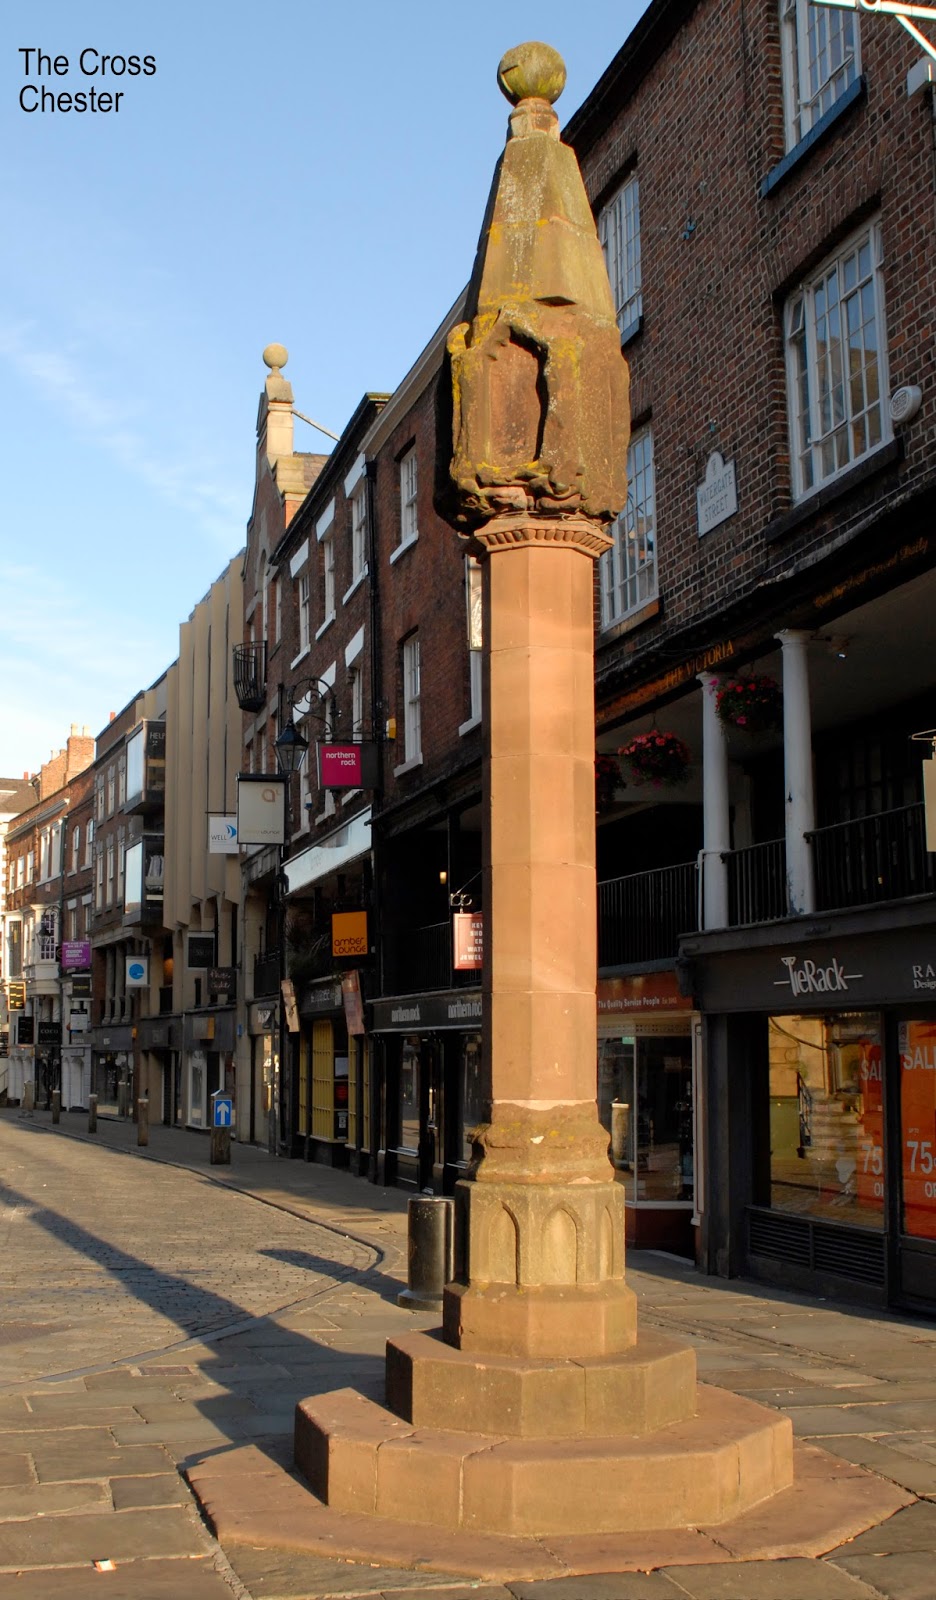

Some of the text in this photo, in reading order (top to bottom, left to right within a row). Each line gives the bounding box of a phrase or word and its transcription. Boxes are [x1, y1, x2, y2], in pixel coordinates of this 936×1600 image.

[699, 470, 733, 507] WATERGATE
[704, 493, 729, 523] STREET
[685, 639, 735, 678] VICTORIA
[149, 731, 166, 739] HELP
[325, 751, 356, 759] northern
[333, 945, 367, 954] LOUNGE
[334, 937, 365, 947] amber
[447, 999, 471, 1018] northern
[598, 1000, 607, 1009] The
[607, 999, 623, 1010] Quality
[623, 997, 642, 1007] Service
[642, 995, 661, 1007] People
[903, 1045, 936, 1071] SAL
[906, 1140, 936, 1175] 75
